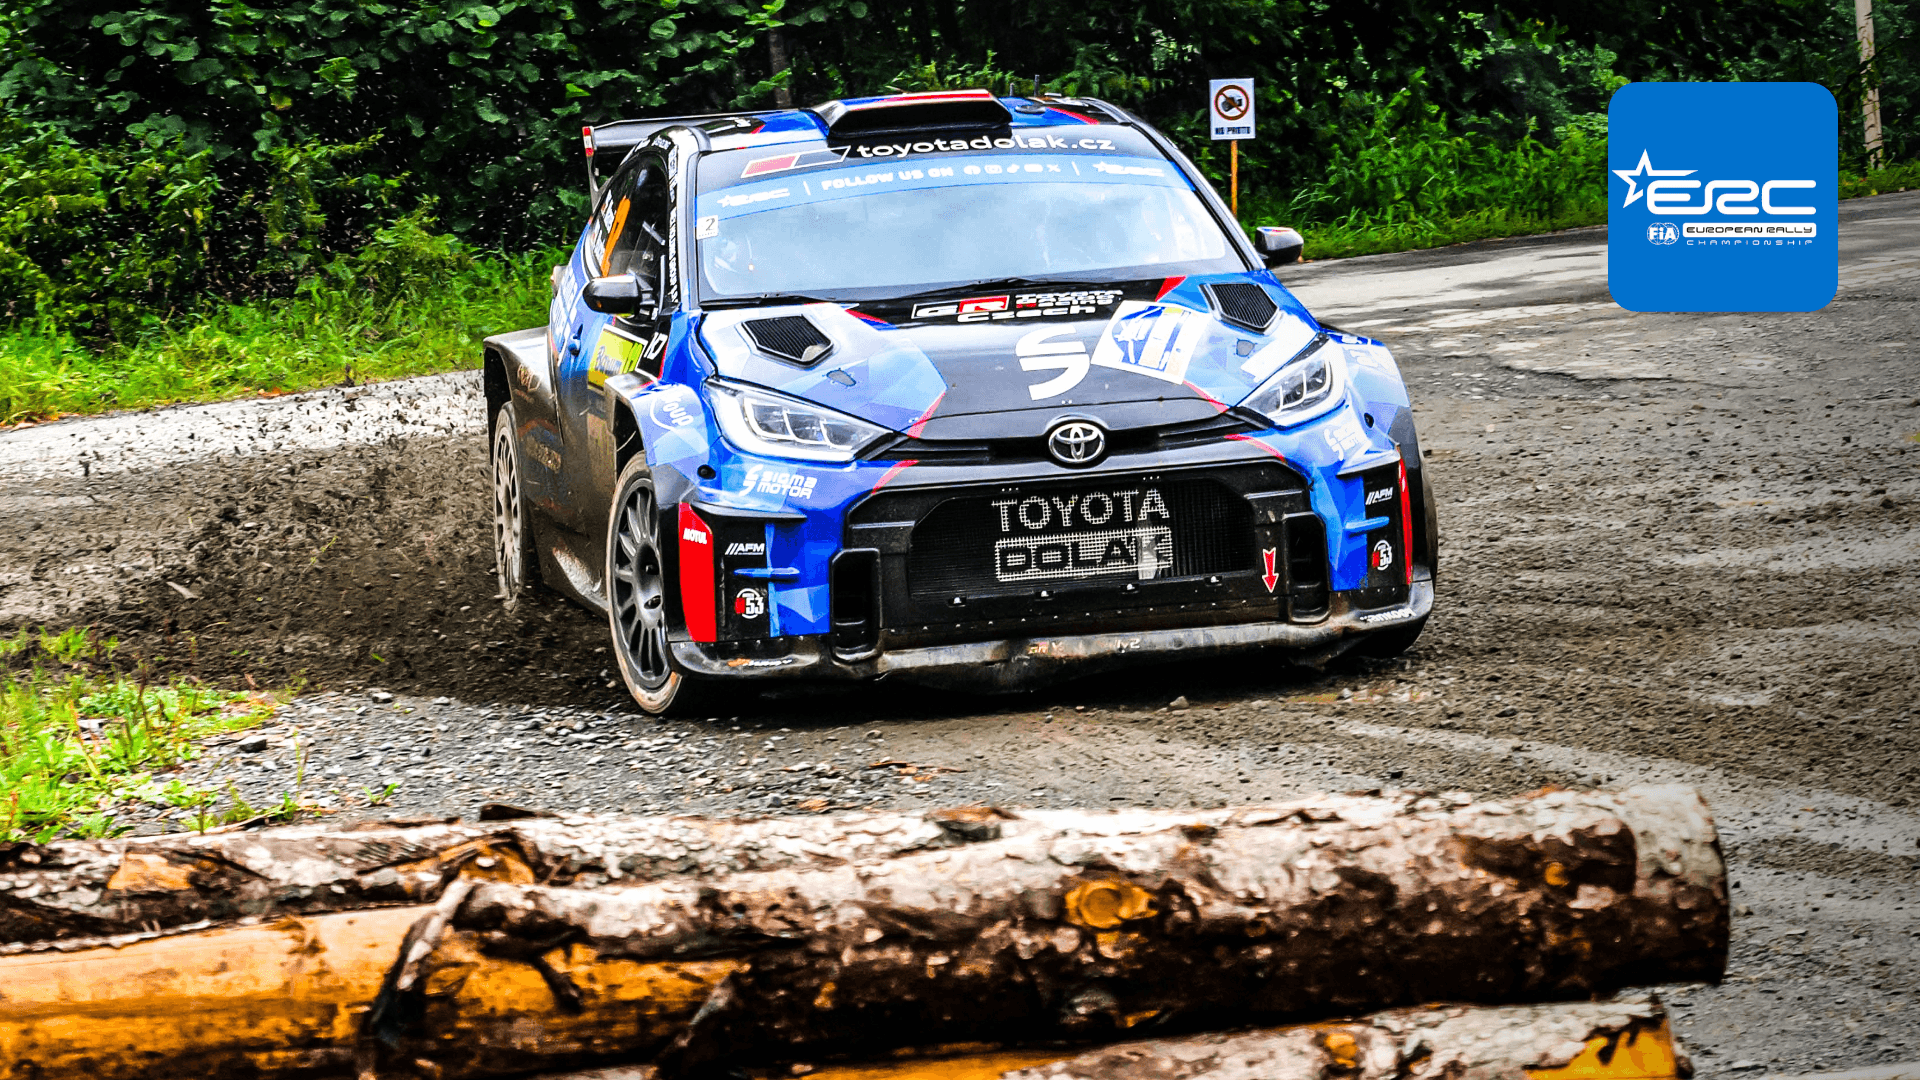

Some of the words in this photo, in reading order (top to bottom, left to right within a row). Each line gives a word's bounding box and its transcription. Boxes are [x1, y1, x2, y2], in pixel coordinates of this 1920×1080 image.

[857, 135, 1116, 158] toyotadolak.cz
[821, 173, 894, 191] FOLLOW
[898, 169, 924, 180] US
[928, 167, 954, 177] ON
[762, 471, 818, 488] SIGMA
[756, 481, 814, 499] MOTOR
[991, 488, 1170, 531] TOYOTA
[683, 528, 708, 544] MOTUL
